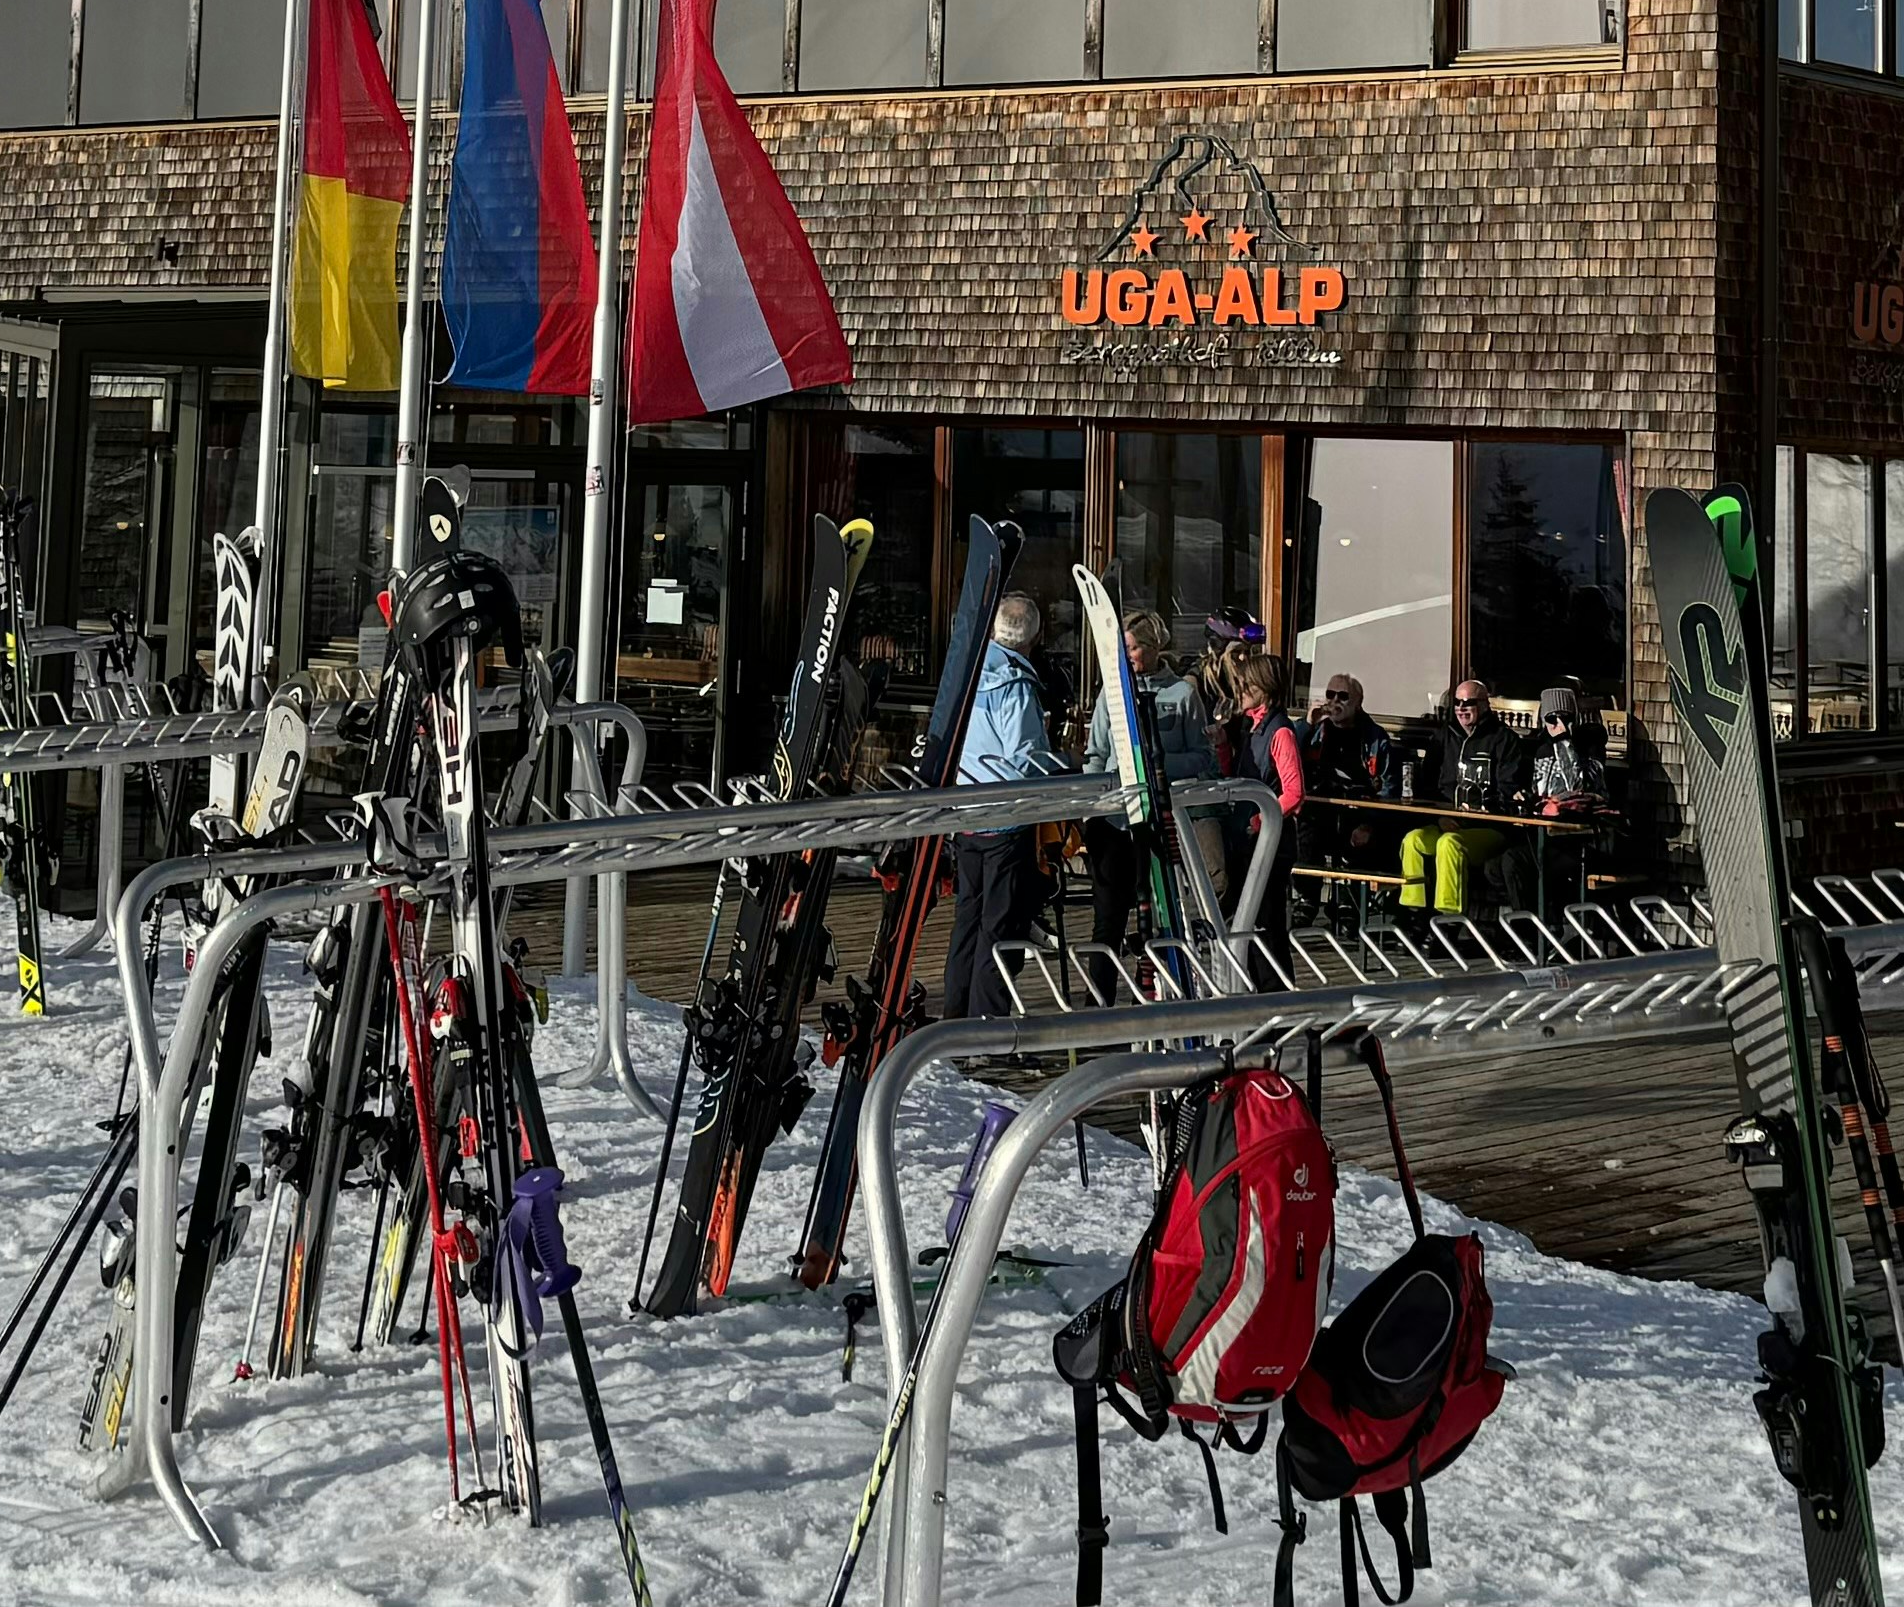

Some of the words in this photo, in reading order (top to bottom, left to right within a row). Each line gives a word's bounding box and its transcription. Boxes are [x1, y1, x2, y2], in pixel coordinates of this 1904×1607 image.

[1062, 267, 1344, 325] UGA-ALP
[811, 587, 839, 684] FACTION
[1667, 602, 1748, 773] K2
[1285, 1189, 1317, 1202] deuter
